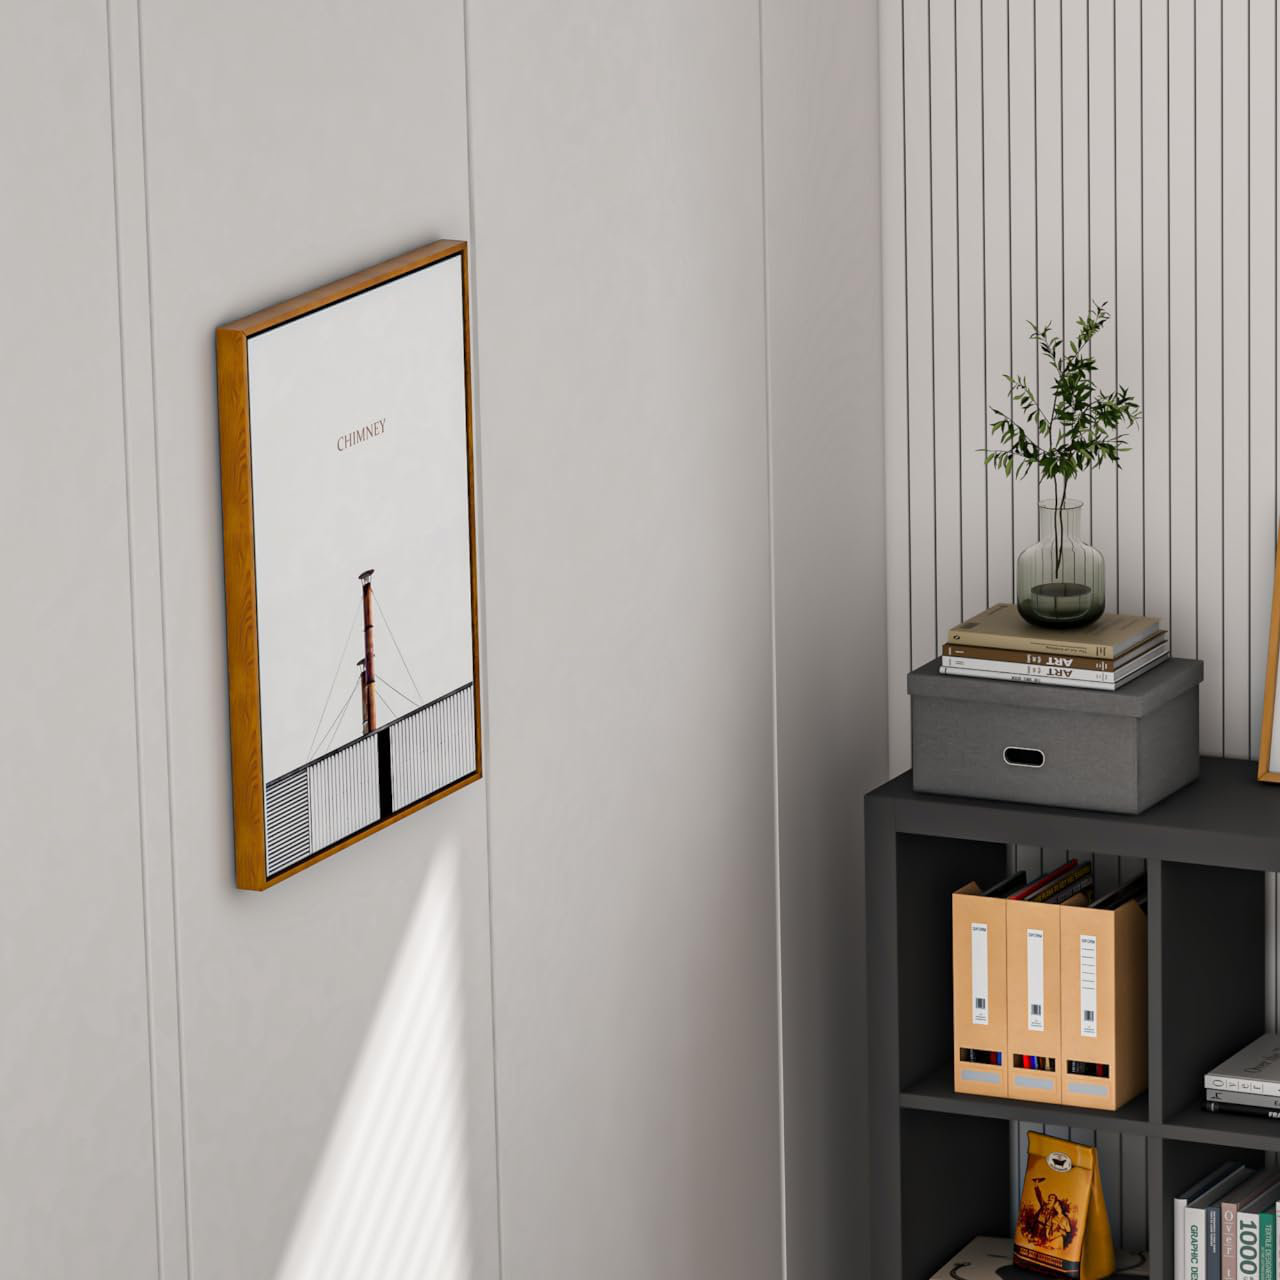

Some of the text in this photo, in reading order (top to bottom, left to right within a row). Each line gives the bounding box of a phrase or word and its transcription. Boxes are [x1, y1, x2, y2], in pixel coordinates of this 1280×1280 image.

[337, 418, 387, 452] CHIMNEY
[1046, 656, 1073, 667] ART
[1047, 667, 1073, 678] ART
[1190, 1225, 1199, 1264] GRAPHIC
[1239, 1220, 1258, 1275] 1000
